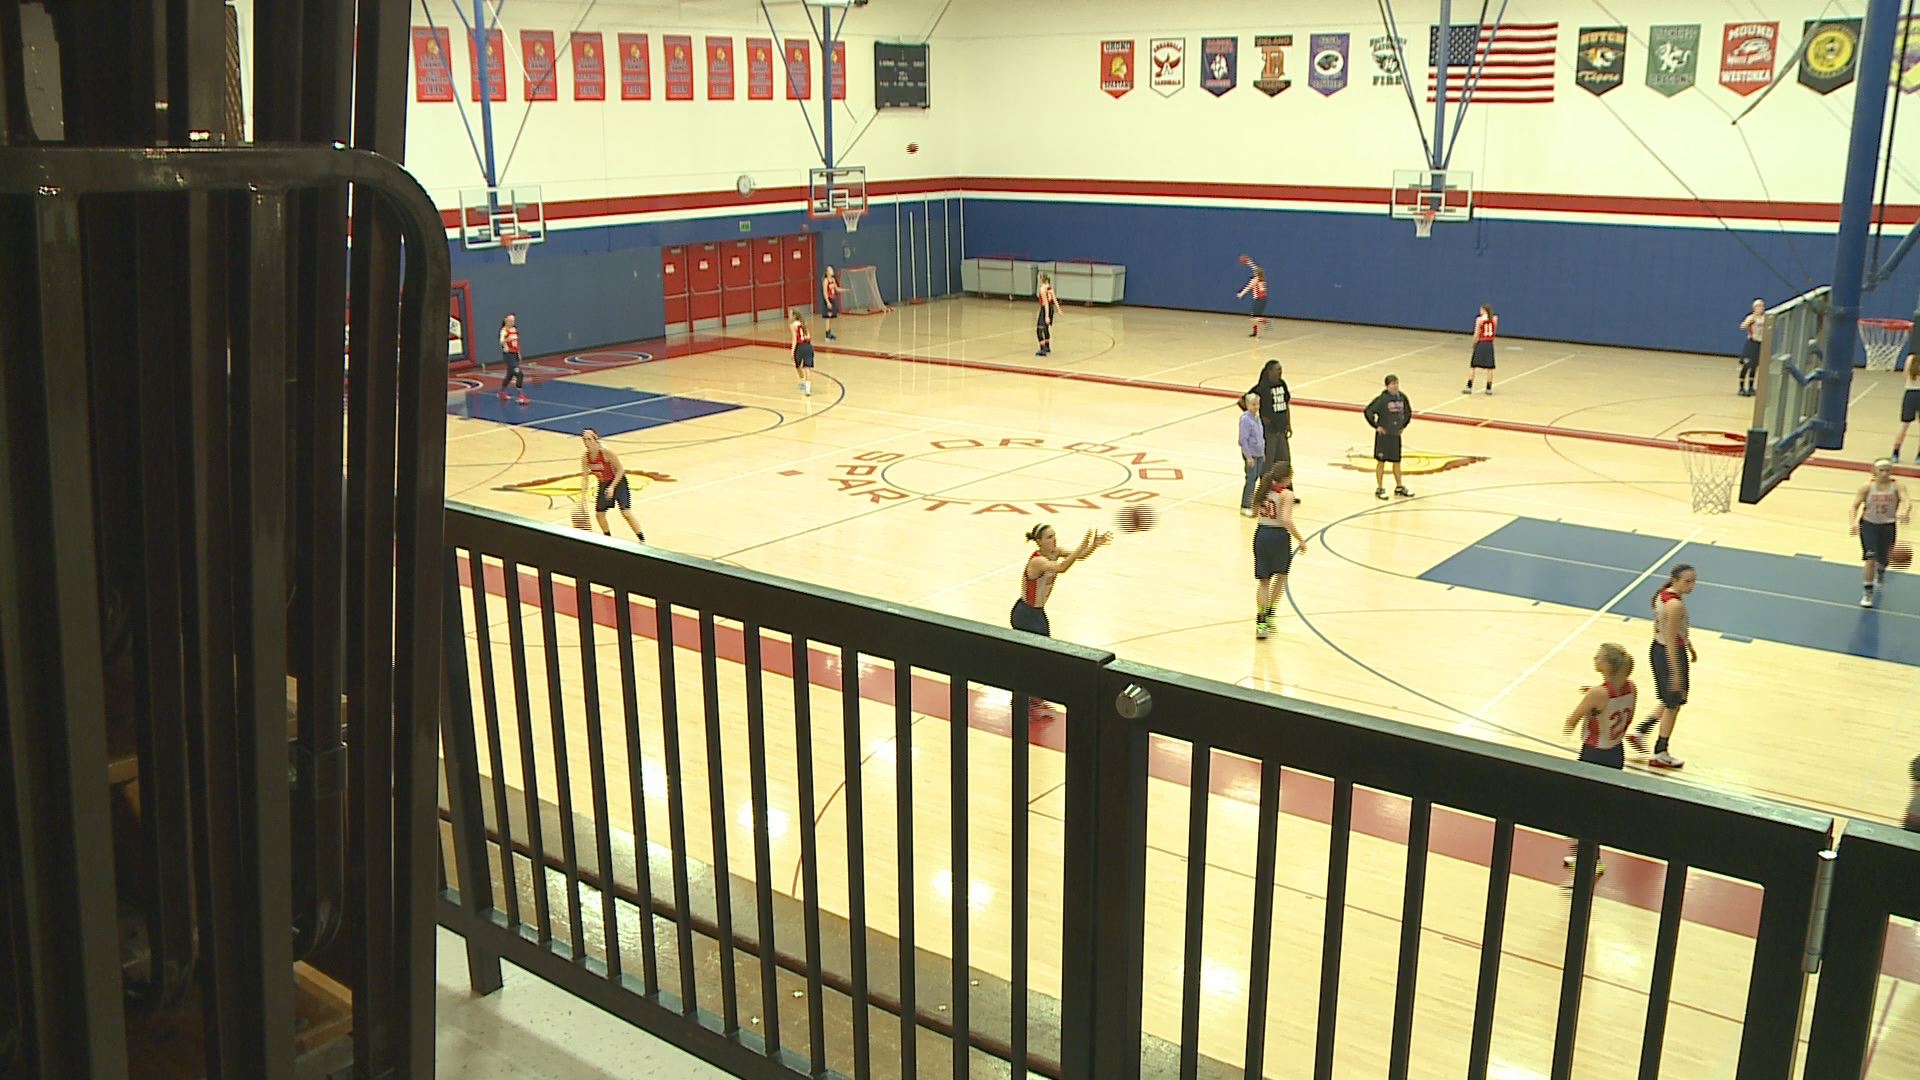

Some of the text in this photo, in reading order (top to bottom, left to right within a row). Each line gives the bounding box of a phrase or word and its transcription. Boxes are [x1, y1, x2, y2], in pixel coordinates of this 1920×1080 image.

[1580, 31, 1625, 45] HUTCH
[1728, 24, 1774, 41] MOUND
[1104, 41, 1131, 52] ORONO
[828, 450, 1159, 515] SPARTANS
